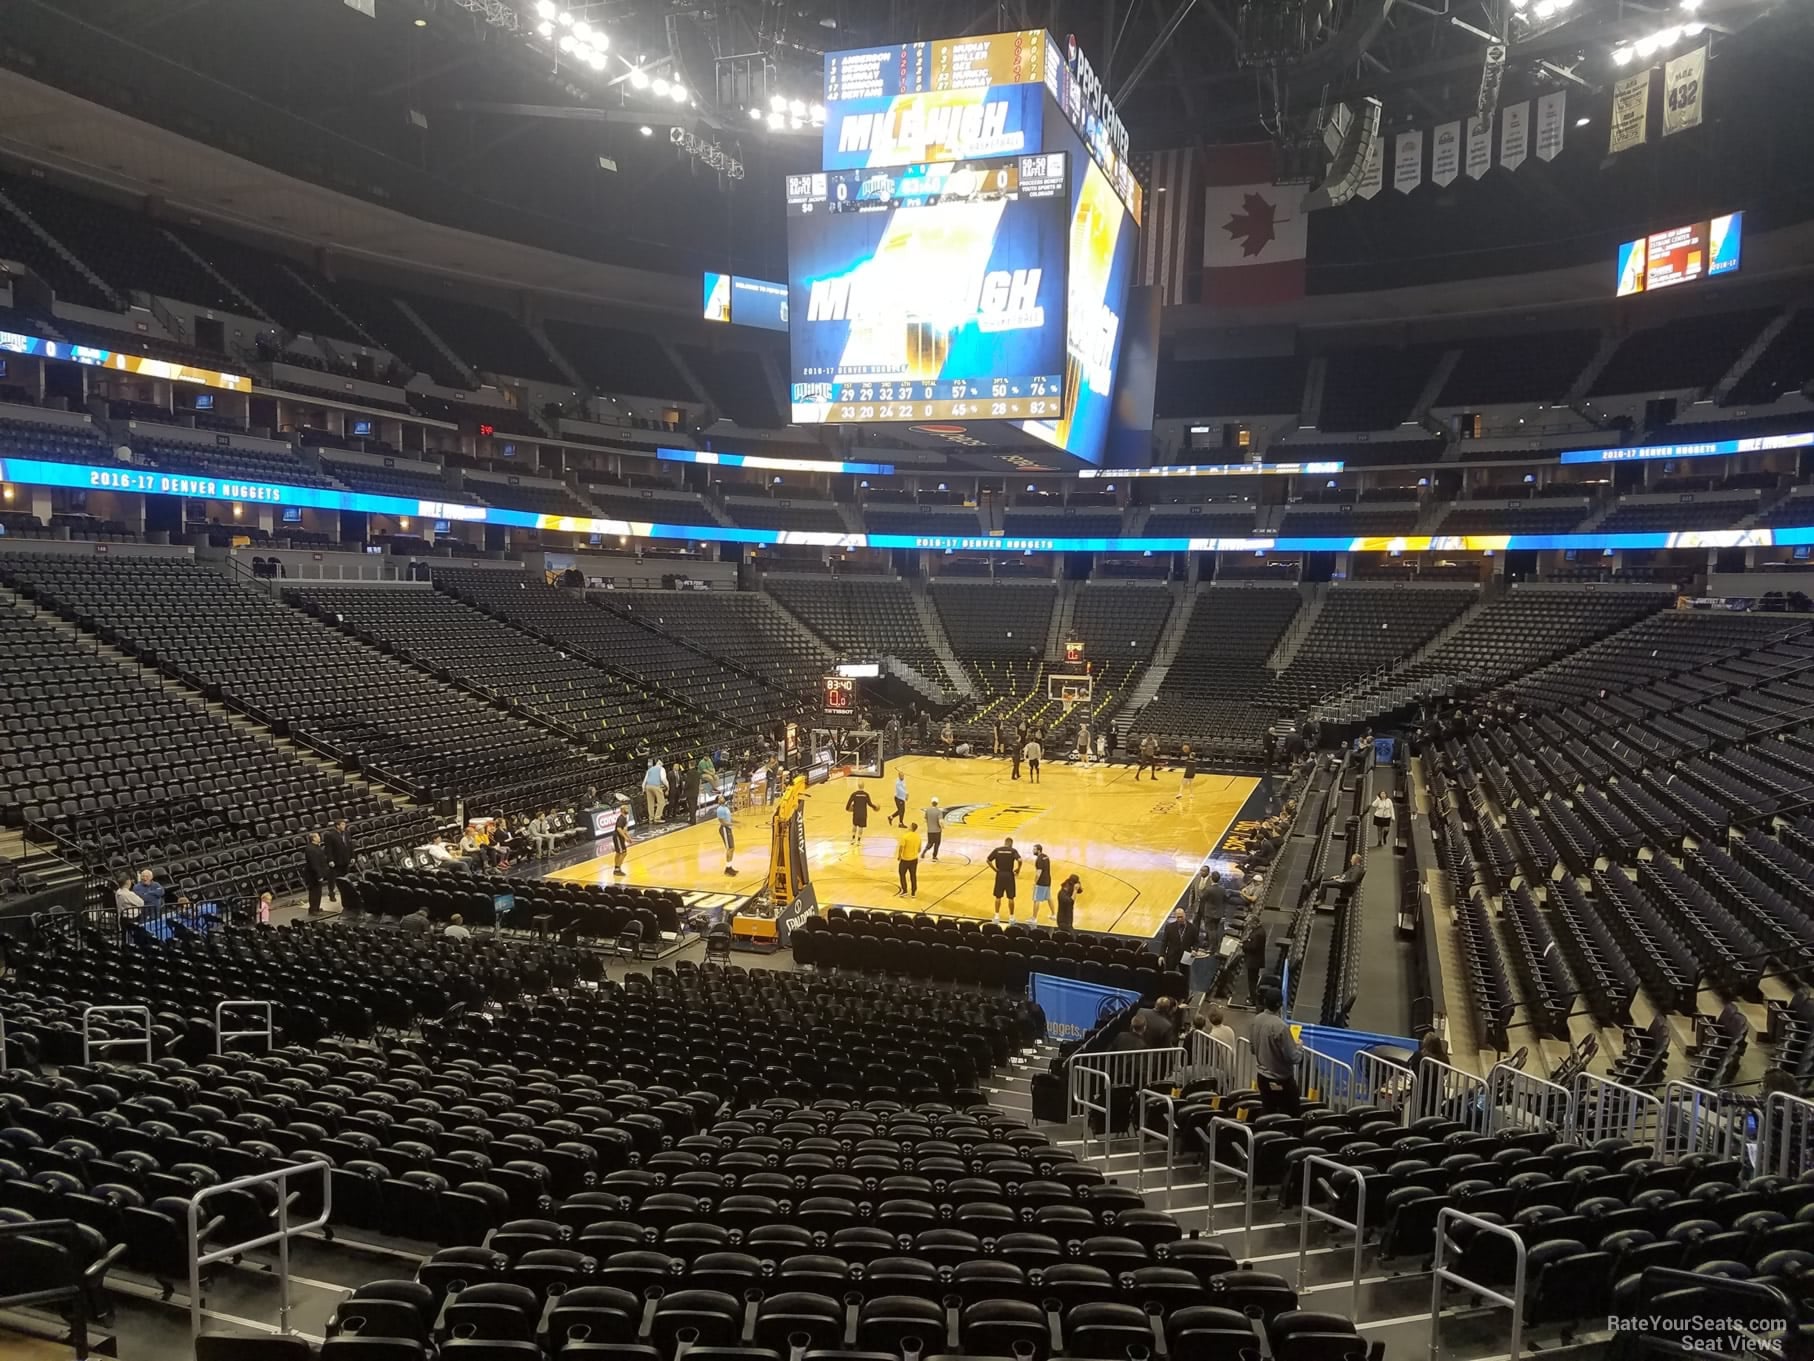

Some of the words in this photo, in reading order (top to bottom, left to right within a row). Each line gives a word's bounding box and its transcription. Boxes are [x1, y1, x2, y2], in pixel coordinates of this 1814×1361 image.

[1668, 80, 1697, 111] 432
[1077, 47, 1102, 119] PEPSI
[1102, 93, 1130, 163] CENTER
[997, 170, 1008, 189] 0
[1022, 167, 1046, 178] RAFFLE
[837, 183, 848, 200] 0
[46, 340, 56, 357] 0
[116, 353, 126, 370] 0
[841, 388, 855, 401] 29
[860, 388, 874, 401] 29
[879, 388, 893, 400] 32
[898, 387, 912, 400] 37
[925, 387, 933, 399] 0
[951, 385, 967, 398] 57
[991, 385, 1007, 397] 50
[1030, 383, 1045, 396] 76
[841, 406, 855, 418] 33
[860, 406, 874, 418] 20
[898, 405, 912, 417] 22
[925, 404, 933, 417] 0
[951, 403, 967, 416] 45
[991, 403, 1007, 415] 28
[1030, 401, 1045, 414] 82
[1602, 449, 1636, 459] 2016-17
[1639, 447, 1672, 457] DENVER
[1676, 444, 1716, 455] NUGGETS
[90, 470, 154, 490] 2016-17
[161, 477, 216, 495] DENVER
[222, 483, 281, 501] NUGGETS
[916, 538, 957, 547] 2016-17
[962, 539, 1002, 548] DENVER
[1006, 540, 1053, 549] NUGGETS
[827, 680, 852, 690] 83:40
[404, 857, 413, 870] G
[419, 854, 428, 865] G
[786, 904, 816, 936] SPALDING
